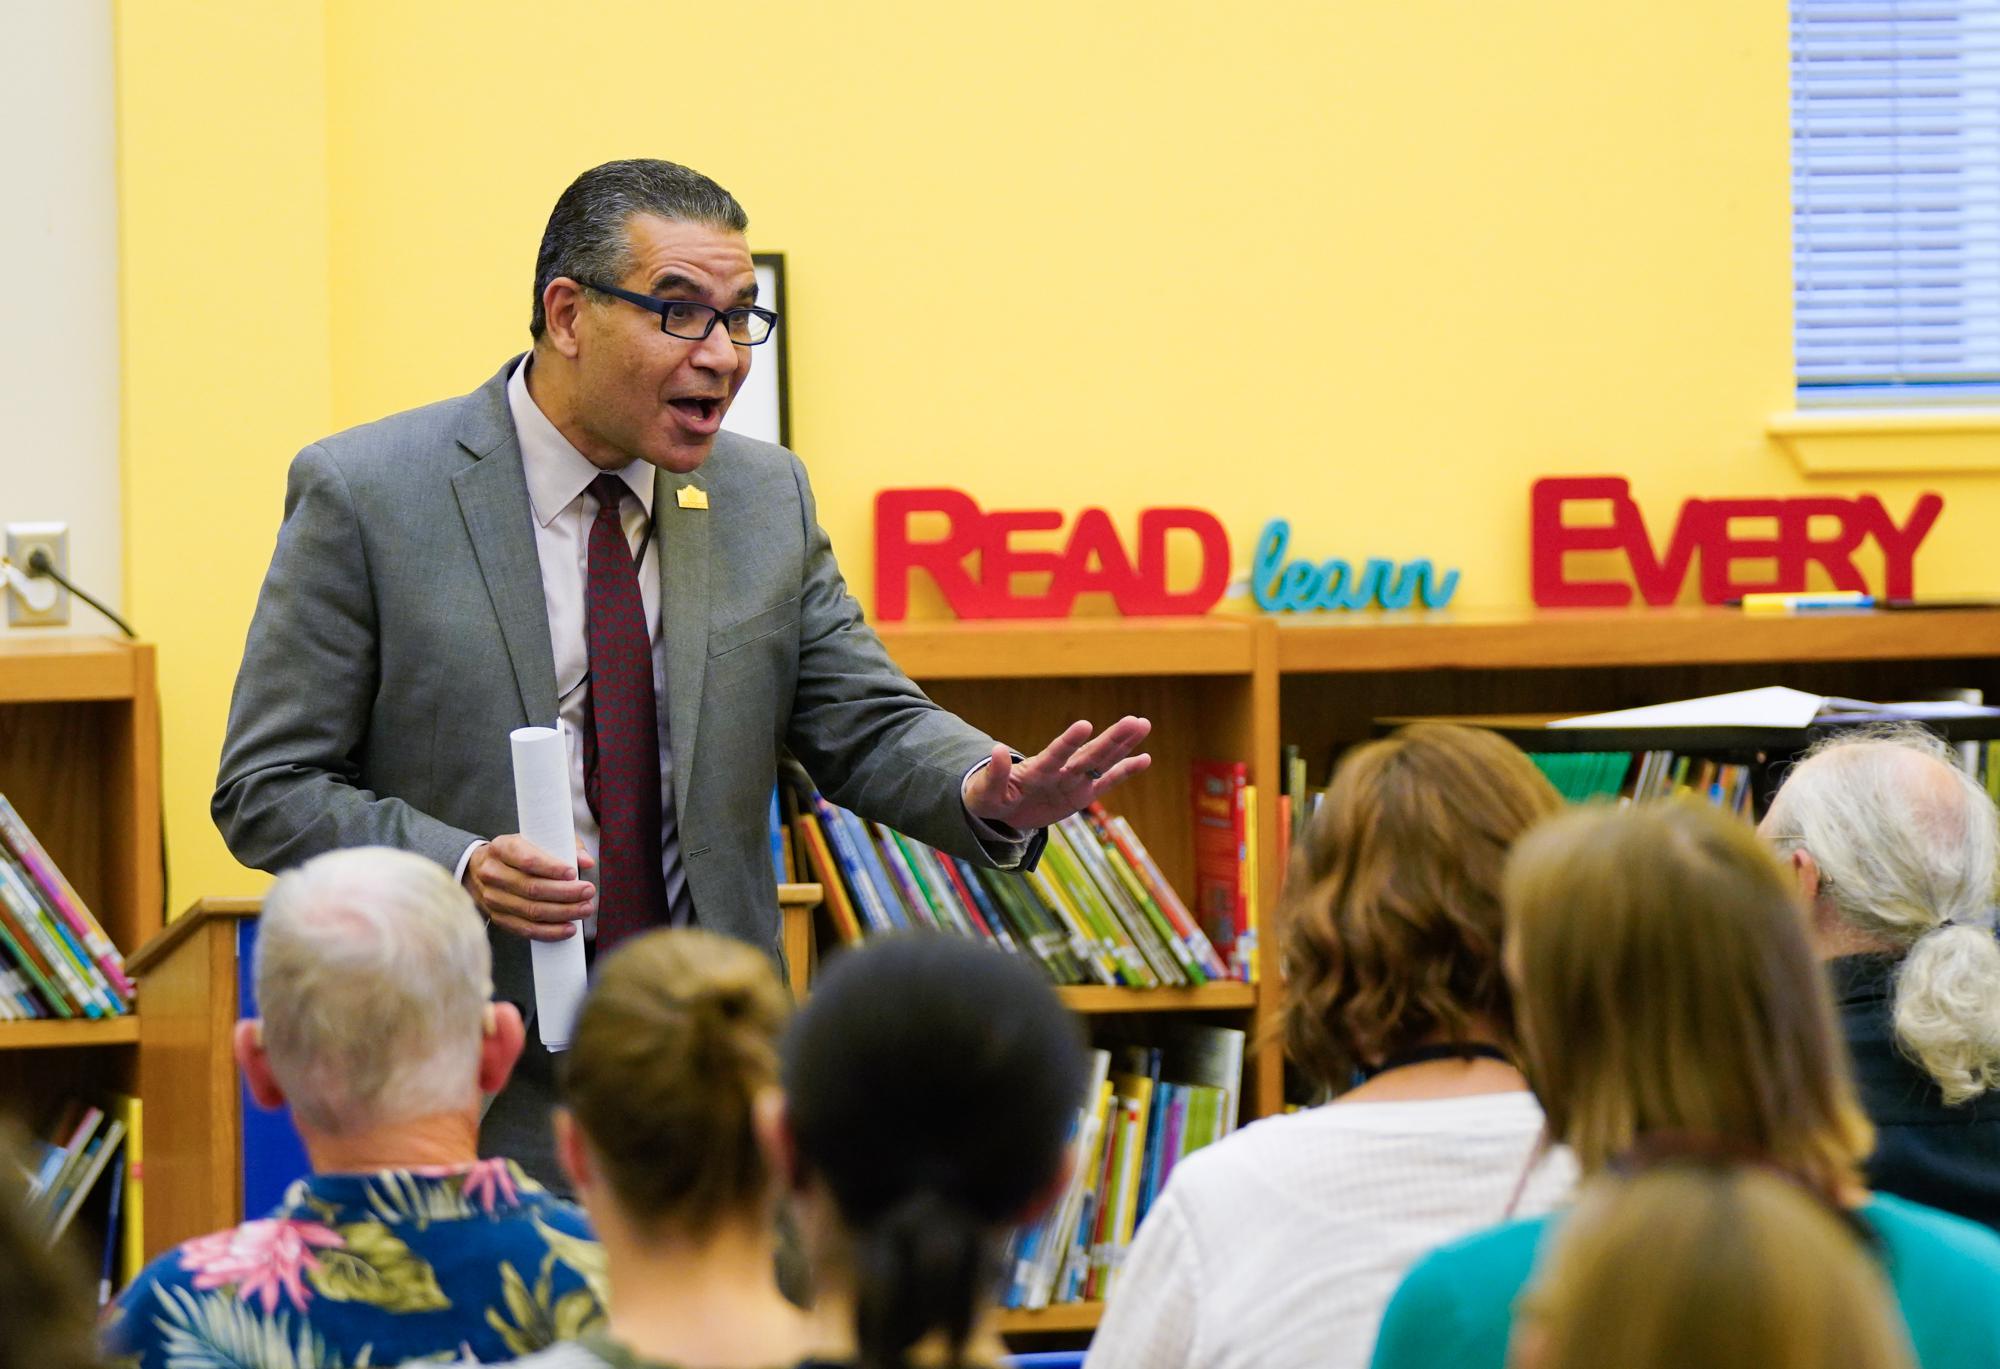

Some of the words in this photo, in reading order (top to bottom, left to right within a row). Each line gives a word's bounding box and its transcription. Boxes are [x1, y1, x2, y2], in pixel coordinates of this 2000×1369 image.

[874, 487, 1231, 620] READ
[1251, 518, 1459, 612] learn
[1531, 475, 1944, 607] EVERY
